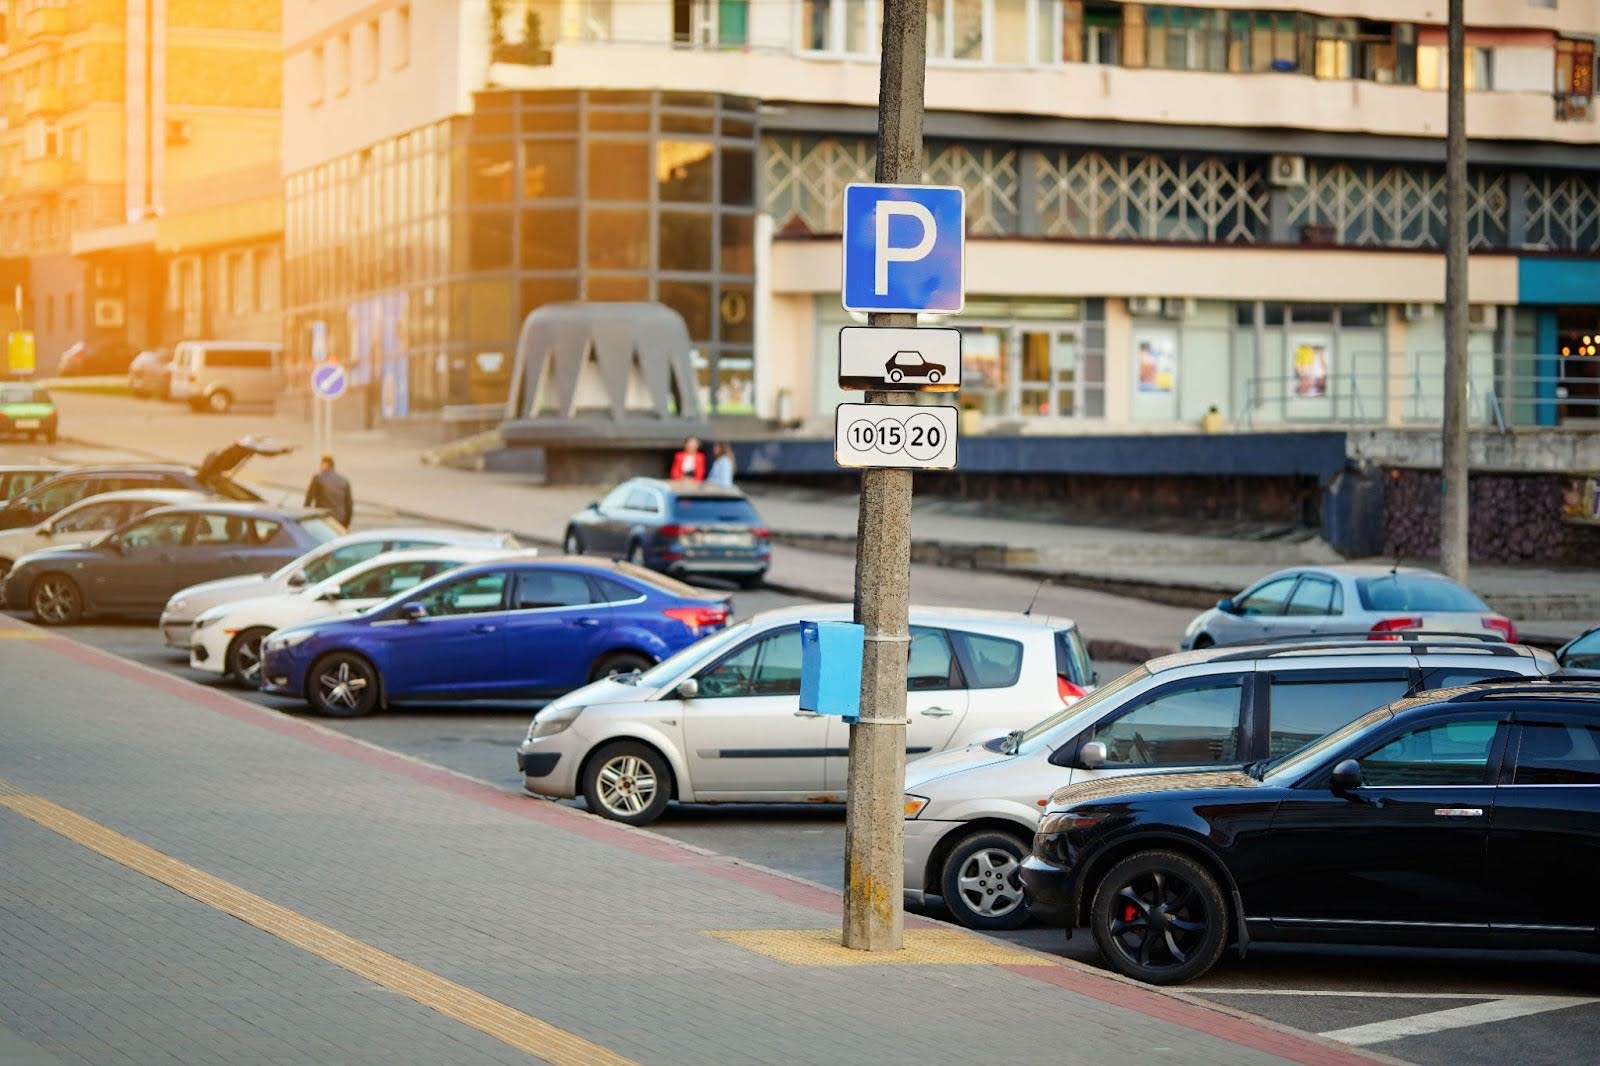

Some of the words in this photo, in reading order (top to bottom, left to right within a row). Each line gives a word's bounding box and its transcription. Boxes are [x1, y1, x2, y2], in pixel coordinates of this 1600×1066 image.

[875, 200, 937, 295] P
[853, 427, 874, 444] 10
[878, 426, 901, 446] 15
[910, 426, 940, 447] 20
